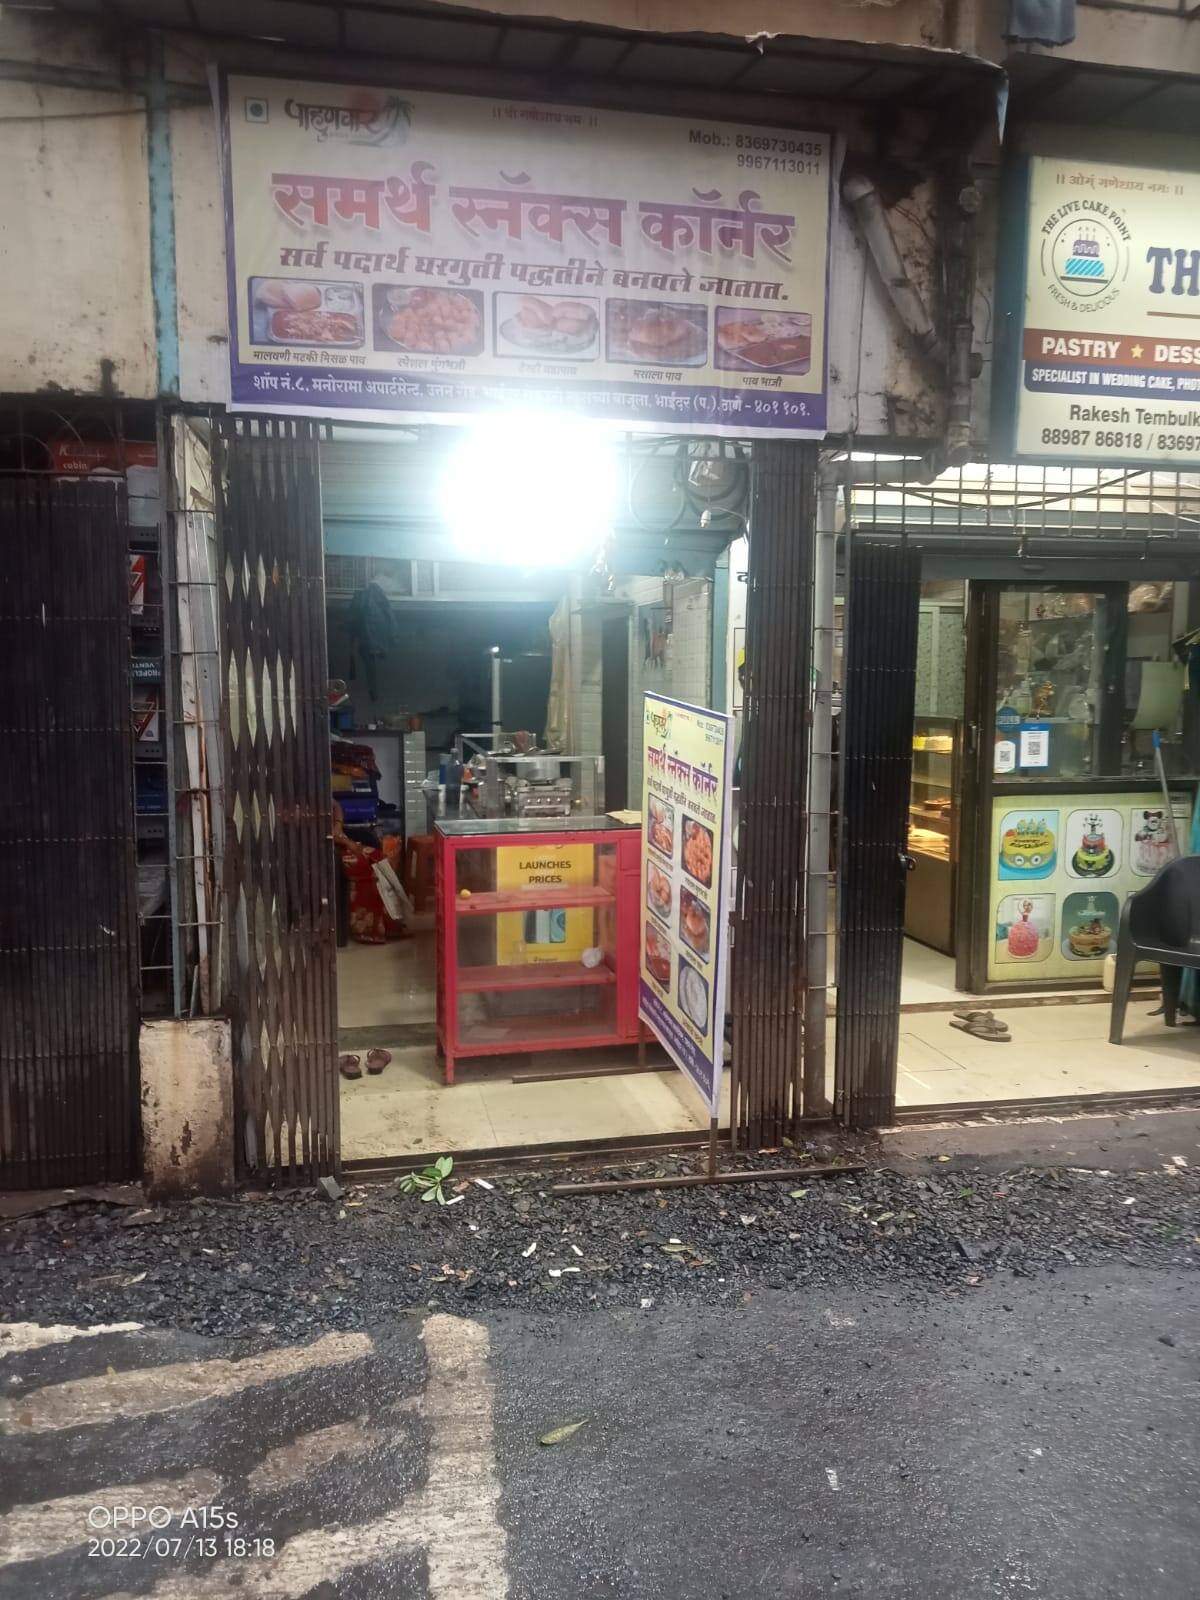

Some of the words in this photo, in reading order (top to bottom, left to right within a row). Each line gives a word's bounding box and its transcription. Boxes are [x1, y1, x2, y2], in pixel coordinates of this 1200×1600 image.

[735, 134, 822, 157] 8369730435
[736, 154, 821, 175] 9967113011
[271, 160, 437, 234] समर्थ
[448, 169, 628, 248] स्नॅक्स
[638, 187, 796, 263] कॉर्नर
[1041, 214, 1060, 236] THE
[1057, 200, 1081, 218] LIVE
[1082, 199, 1109, 217] CAKE
[1108, 210, 1132, 241] POINT
[280, 241, 330, 269] सर्व
[334, 246, 411, 275] पदार्थ
[415, 252, 505, 287] घरगुती
[510, 257, 608, 287] पद्धतीने
[612, 267, 694, 293] बनवले
[700, 275, 789, 301] जातात.
[1048, 283, 1071, 308] FRESH
[1041, 336, 1121, 359] PASTRY
[349, 354, 367, 365] पाव
[253, 371, 278, 390] शॉप
[665, 371, 683, 382] पाव
[742, 376, 759, 385] पाव
[761, 376, 783, 387] भाजी
[1031, 367, 1088, 384] SPECIALIST
[1089, 372, 1101, 385] IN
[1101, 373, 1146, 388] WEDDING
[1148, 375, 1176, 392] CAKE,
[1069, 404, 1130, 424] Rakesh
[1041, 427, 1090, 445] 88987
[1095, 431, 1143, 448] 86818
[519, 860, 572, 870] LAUNCHES
[528, 875, 563, 884] PRICES
